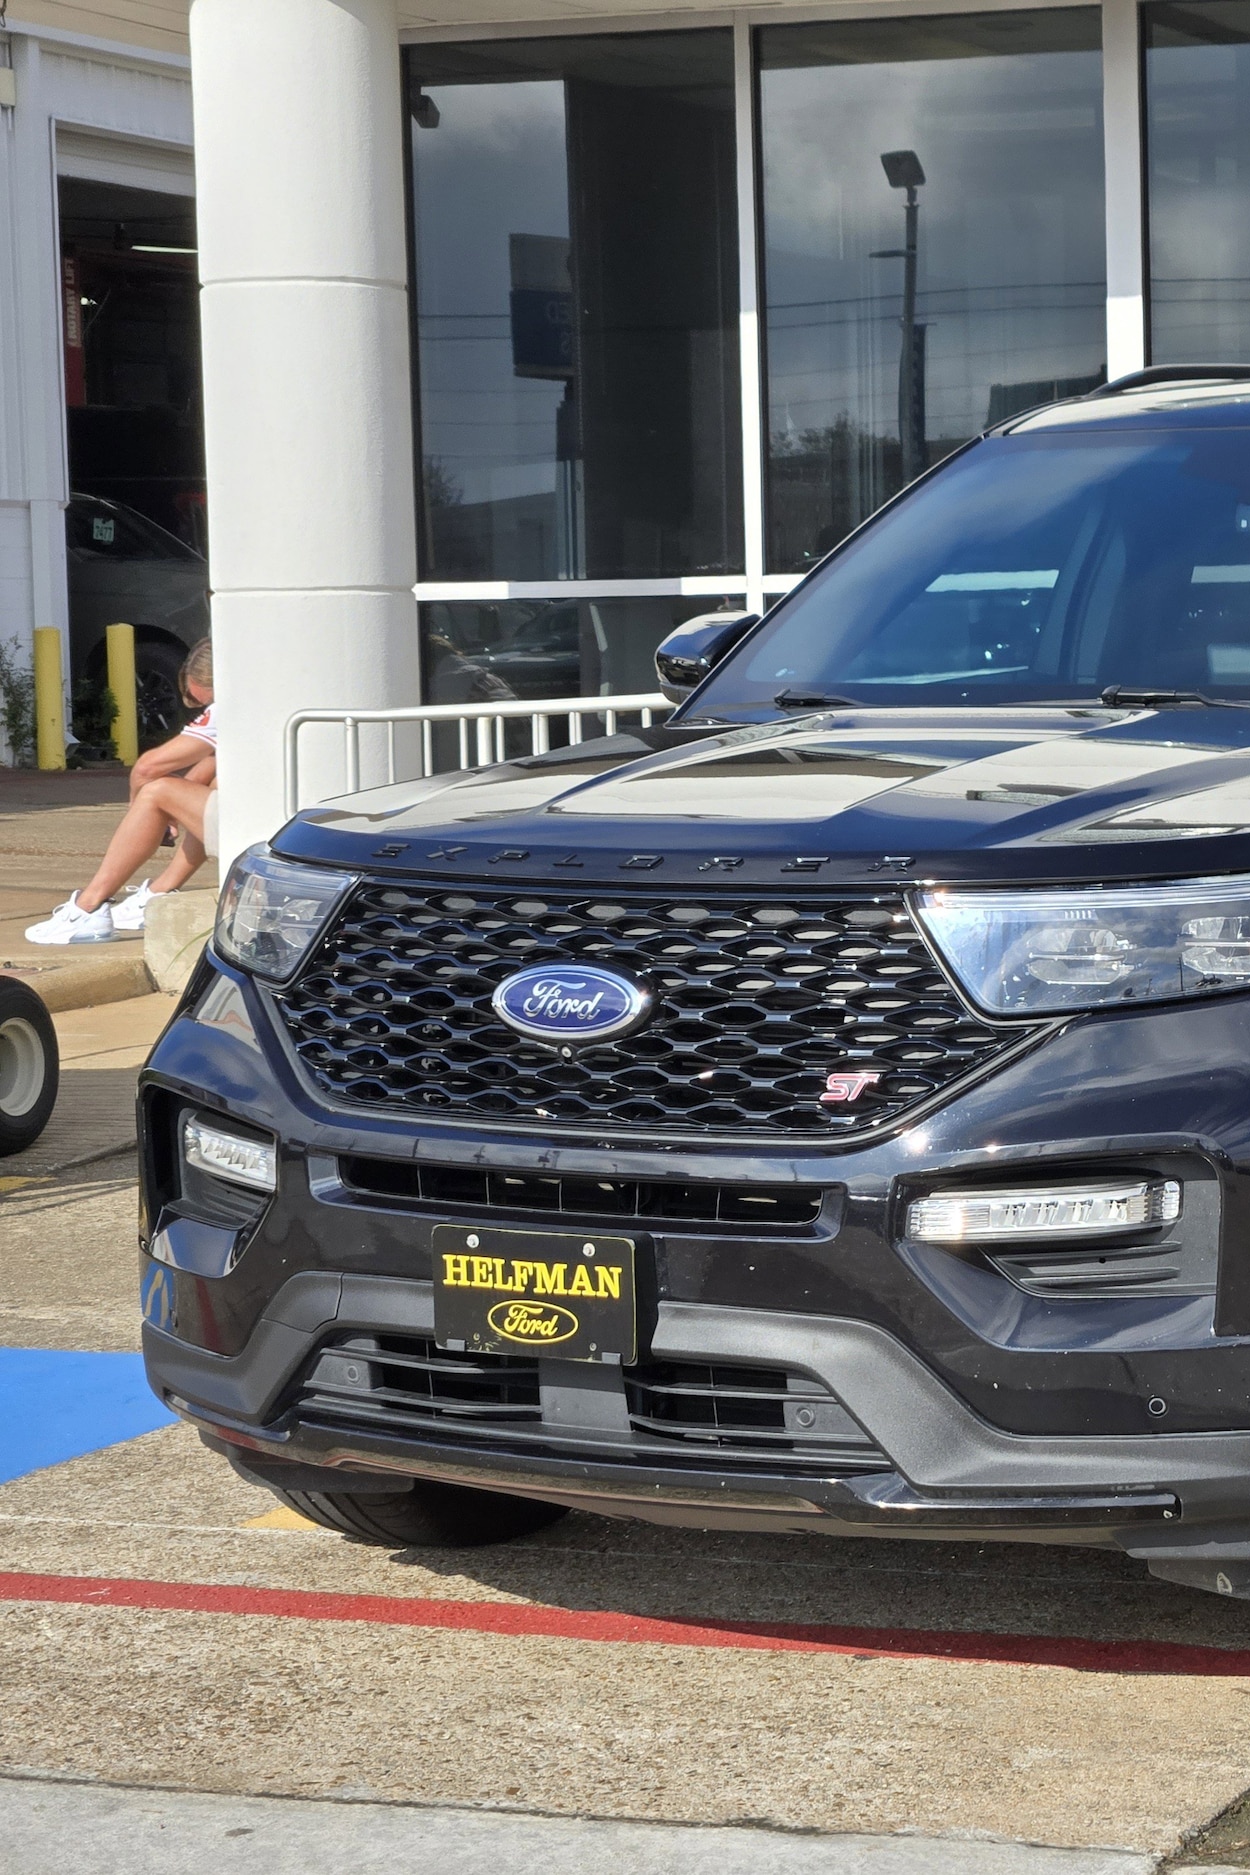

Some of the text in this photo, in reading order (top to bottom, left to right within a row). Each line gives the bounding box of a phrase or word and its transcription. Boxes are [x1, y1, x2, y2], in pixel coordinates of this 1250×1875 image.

[64, 257, 77, 339] ROTARY LIFT
[371, 842, 916, 875] EXPLORER
[523, 978, 605, 1020] Ford
[819, 1073, 880, 1101] ST
[442, 1254, 622, 1299] HELFMAN
[503, 1304, 559, 1337] Ford
